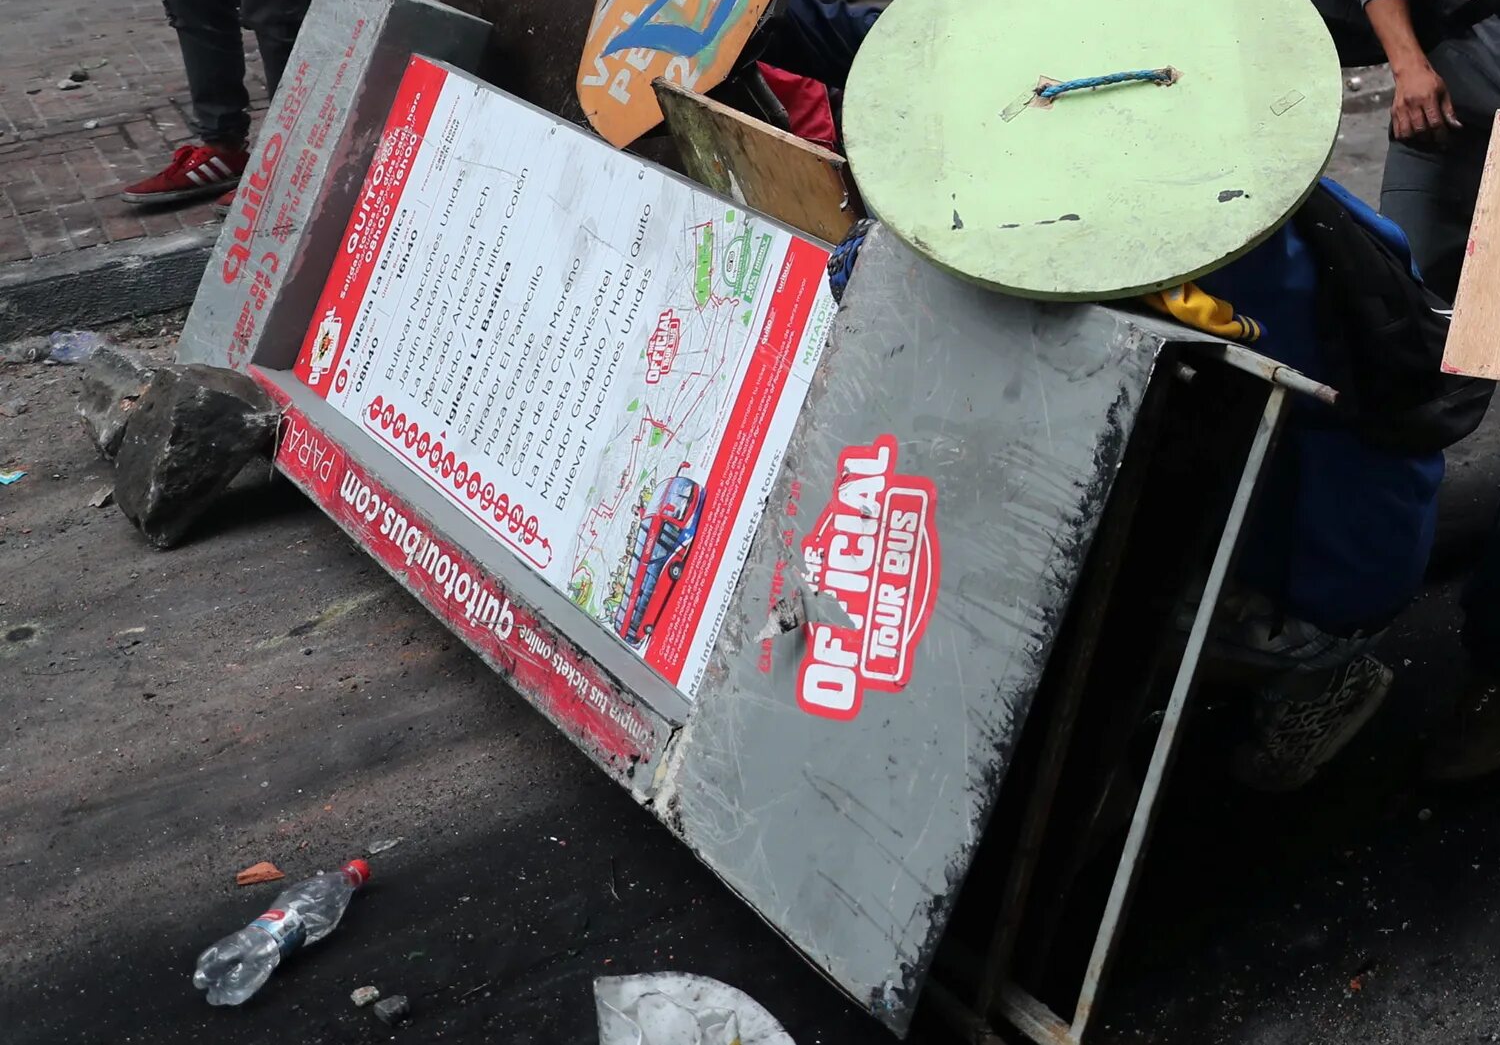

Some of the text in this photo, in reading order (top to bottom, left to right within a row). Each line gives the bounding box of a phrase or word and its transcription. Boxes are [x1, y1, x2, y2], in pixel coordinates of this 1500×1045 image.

[276, 59, 310, 123] TOUR
[282, 83, 308, 130] BUS
[383, 127, 400, 163] TOUR
[433, 117, 456, 170] cada hora
[437, 118, 460, 172] each hour
[219, 131, 286, 282] quito
[339, 252, 360, 300] Salidas
[358, 211, 376, 250] todos
[373, 188, 384, 208] los
[393, 123, 409, 156] cada
[406, 91, 421, 121] hora
[344, 162, 386, 255] QUITO
[351, 221, 377, 282] Departures
[374, 170, 397, 221] everyday
[363, 203, 391, 264] 08h00
[392, 132, 418, 188] 16h00
[394, 228, 419, 281] 16h40
[349, 298, 375, 354] Iglesia
[371, 274, 382, 295] La
[379, 207, 407, 270] Basílica
[384, 314, 413, 381] Bulevar
[409, 231, 444, 311] Naciones
[439, 167, 466, 227] Unidas
[395, 333, 422, 390] Jardín
[417, 251, 452, 331] Botánico
[408, 374, 421, 399] La
[417, 298, 449, 372] Mariscal
[450, 233, 473, 281] Plaza
[468, 183, 491, 229] Foch
[420, 328, 454, 408] Mercado
[449, 240, 487, 326] Artesanal
[432, 397, 443, 417] El
[440, 347, 463, 395] Ejido
[464, 280, 487, 330] Hotel
[482, 222, 509, 278] Hilton
[502, 165, 529, 222] Colón
[759, 318, 775, 346] quito
[801, 307, 827, 366] MITAD
[354, 335, 380, 394] 08h40
[444, 363, 473, 428] Iglesia
[469, 335, 483, 360] La
[478, 258, 512, 333] Basílica
[457, 399, 475, 437] San
[471, 306, 510, 397] Francisco
[470, 372, 502, 448] Mirador
[498, 350, 510, 370] El
[506, 262, 544, 348] Panecillo
[483, 403, 507, 457] Plaza
[503, 329, 536, 402] Grande
[496, 396, 528, 469] Parque
[524, 332, 553, 396] García
[548, 255, 581, 329] Moreno
[510, 427, 534, 479] Casa
[529, 398, 545, 427] de
[541, 376, 554, 396] la
[549, 302, 581, 375] Cultura
[539, 420, 574, 501] Mirador
[569, 333, 607, 421] Guápulo
[608, 262, 634, 316] Hotel
[626, 202, 654, 258] Quito
[555, 265, 652, 512] Bulevar Naciones Unidas
[640, 307, 679, 387] OFFICIAL
[524, 462, 540, 489] La
[536, 377, 572, 461] Floresta
[333, 467, 519, 647] quitotourbus.com
[687, 663, 704, 699] Más
[698, 562, 740, 667] información,
[735, 507, 760, 564] tickets
[759, 446, 781, 494] tours:
[882, 509, 918, 575] BUS
[517, 621, 553, 663] online
[550, 652, 589, 695] tickets
[588, 684, 609, 711] tus
